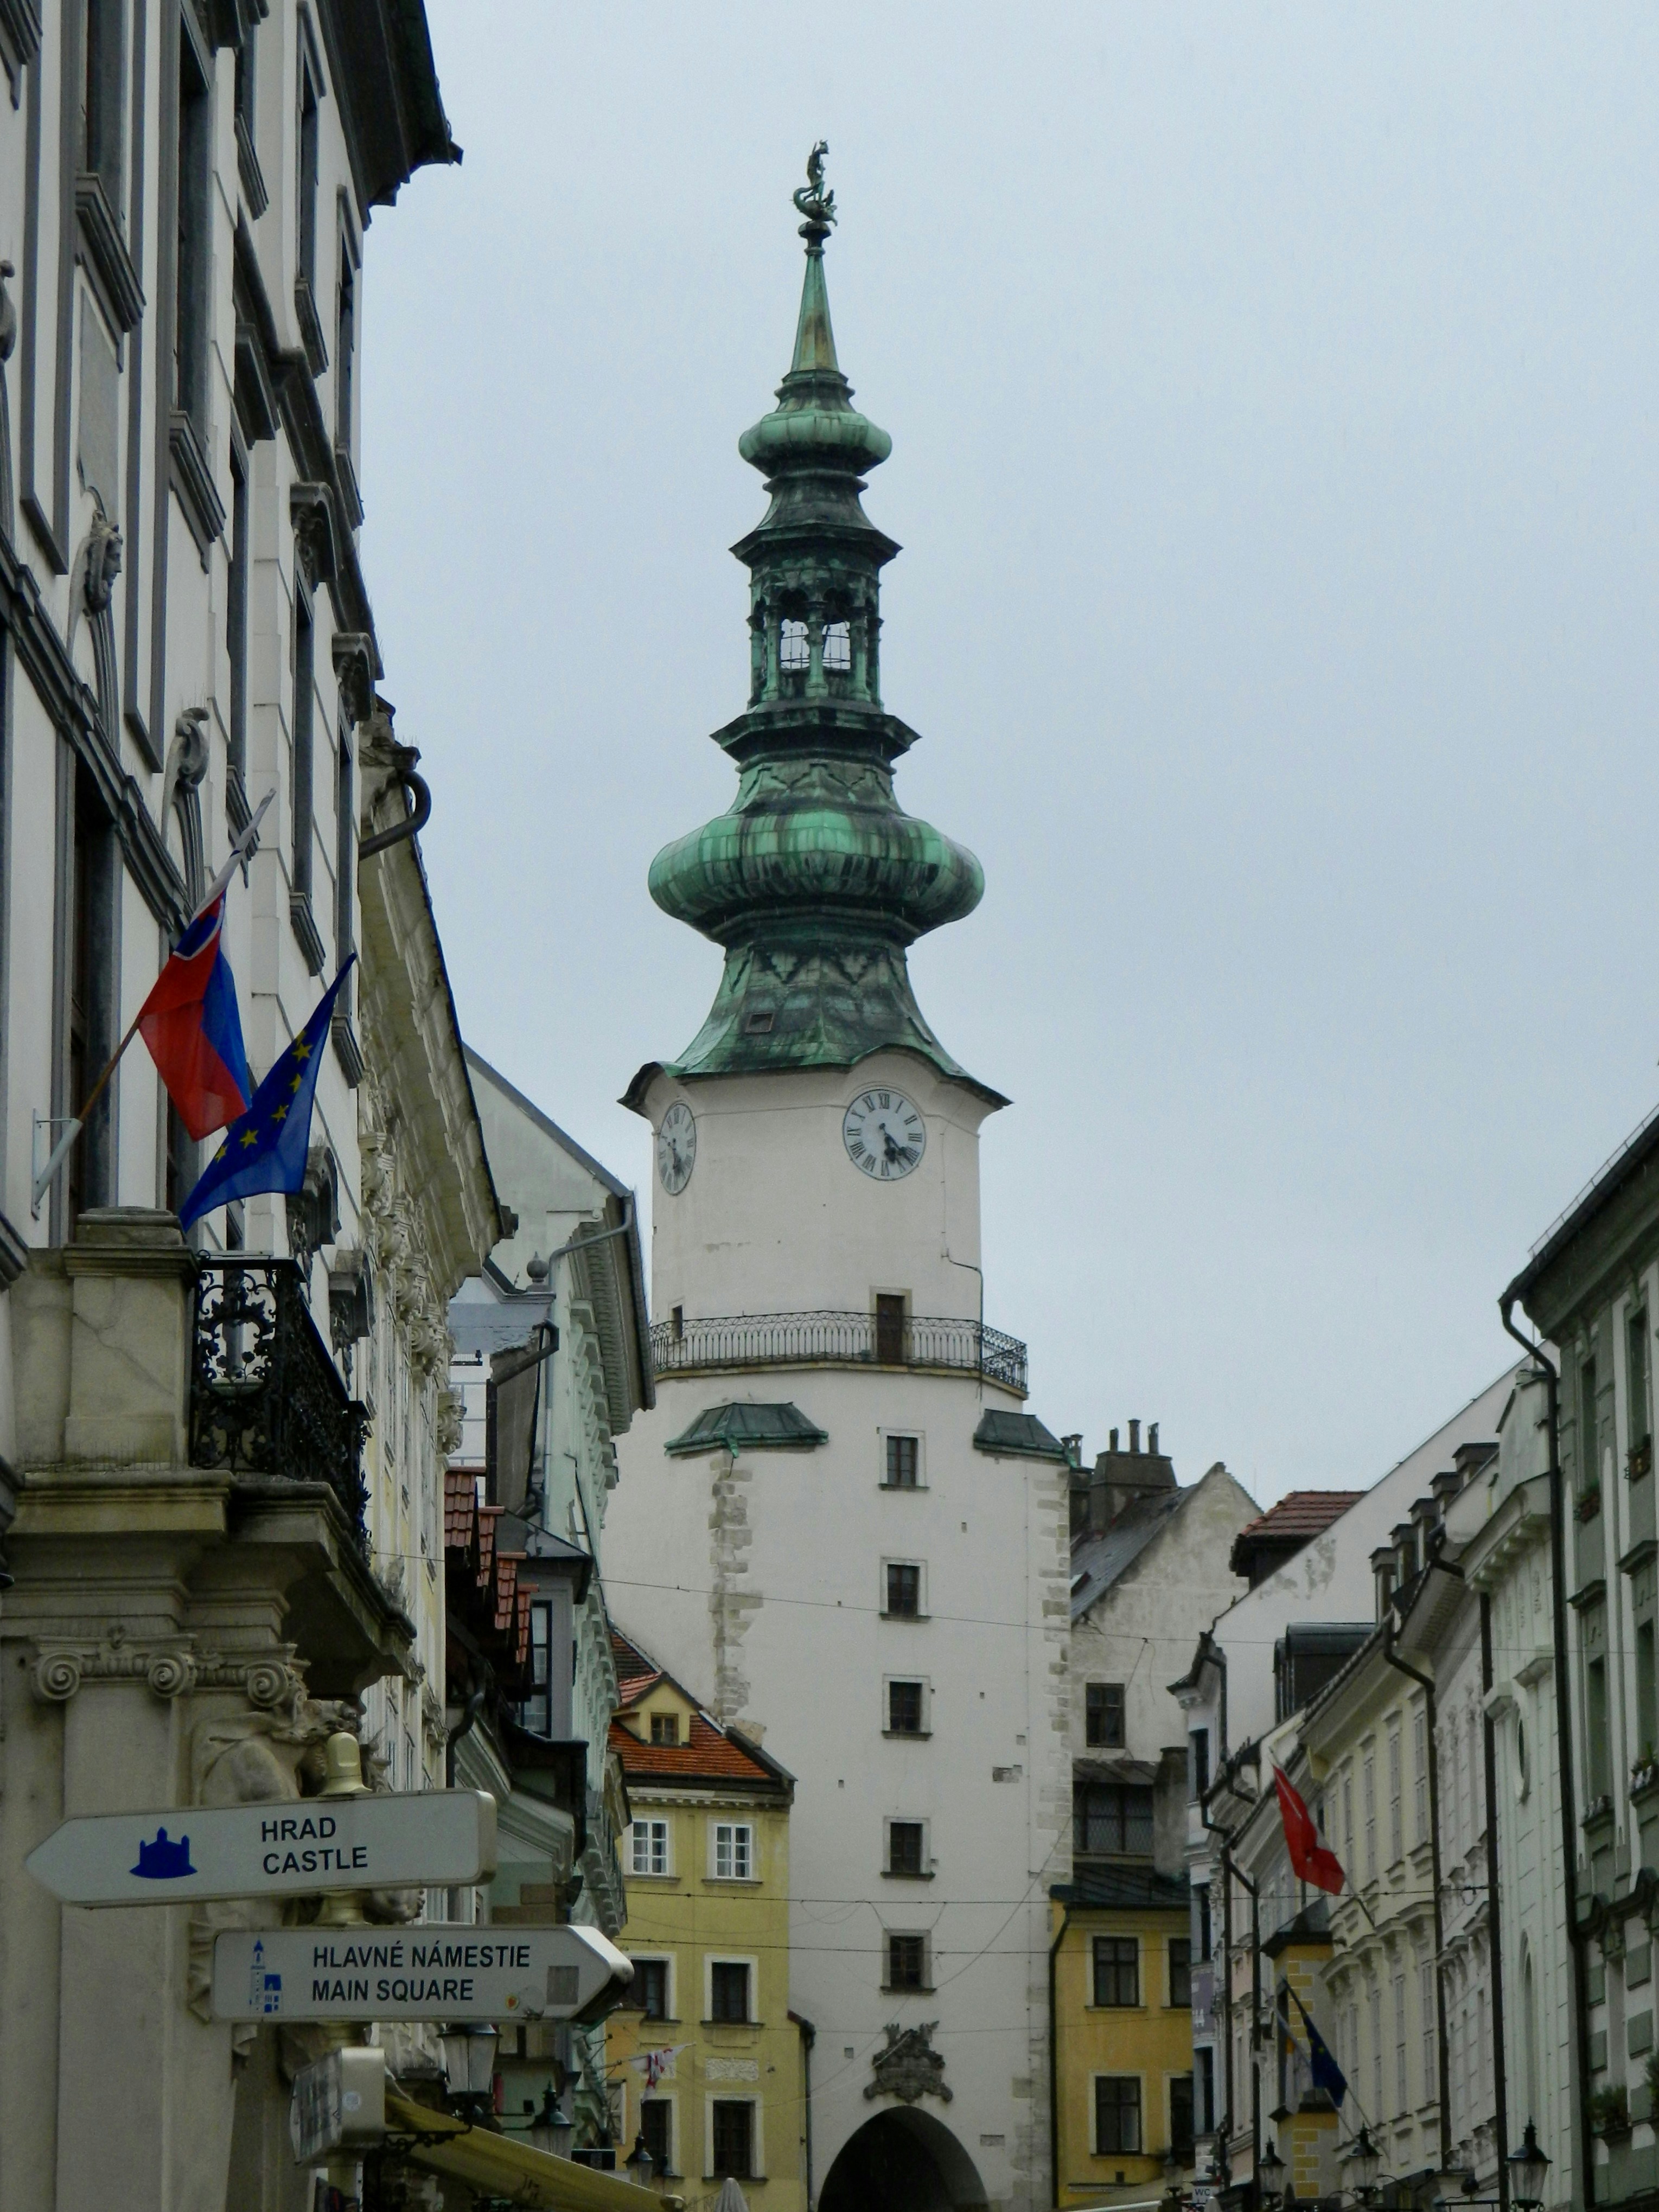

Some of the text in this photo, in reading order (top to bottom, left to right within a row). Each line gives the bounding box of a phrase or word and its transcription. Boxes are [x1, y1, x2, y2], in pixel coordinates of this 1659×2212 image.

[261, 1817, 336, 1842] HRAD
[263, 1846, 368, 1875] CASTLE
[313, 1940, 531, 1968] HLAVNÉ NÁMESTIE
[312, 1978, 474, 2003] MAIN SQUARE
